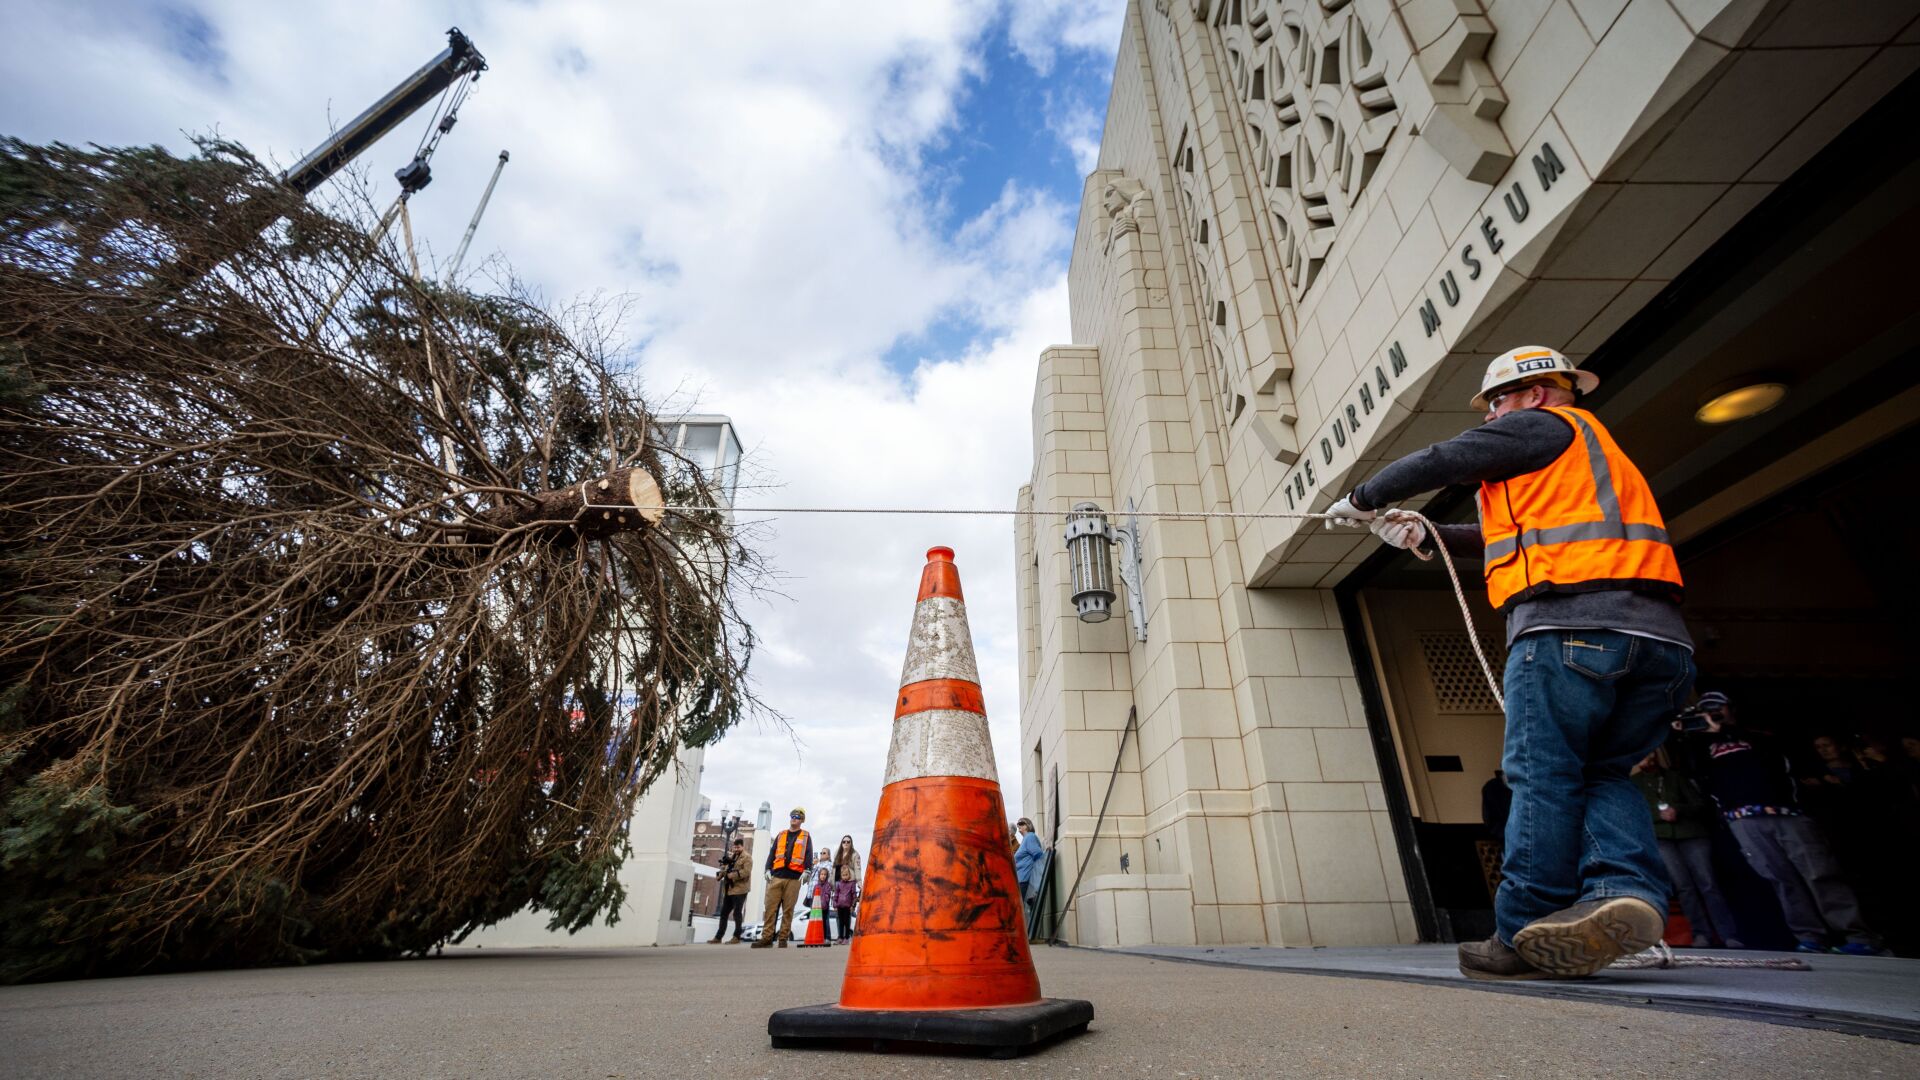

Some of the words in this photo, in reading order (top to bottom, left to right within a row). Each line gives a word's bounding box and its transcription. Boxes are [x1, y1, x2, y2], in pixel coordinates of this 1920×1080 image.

[1285, 459, 1315, 510] THE
[1320, 341, 1408, 465] DURHAM
[1419, 142, 1566, 338] MUSEUM
[1519, 359, 1554, 371] YETI
